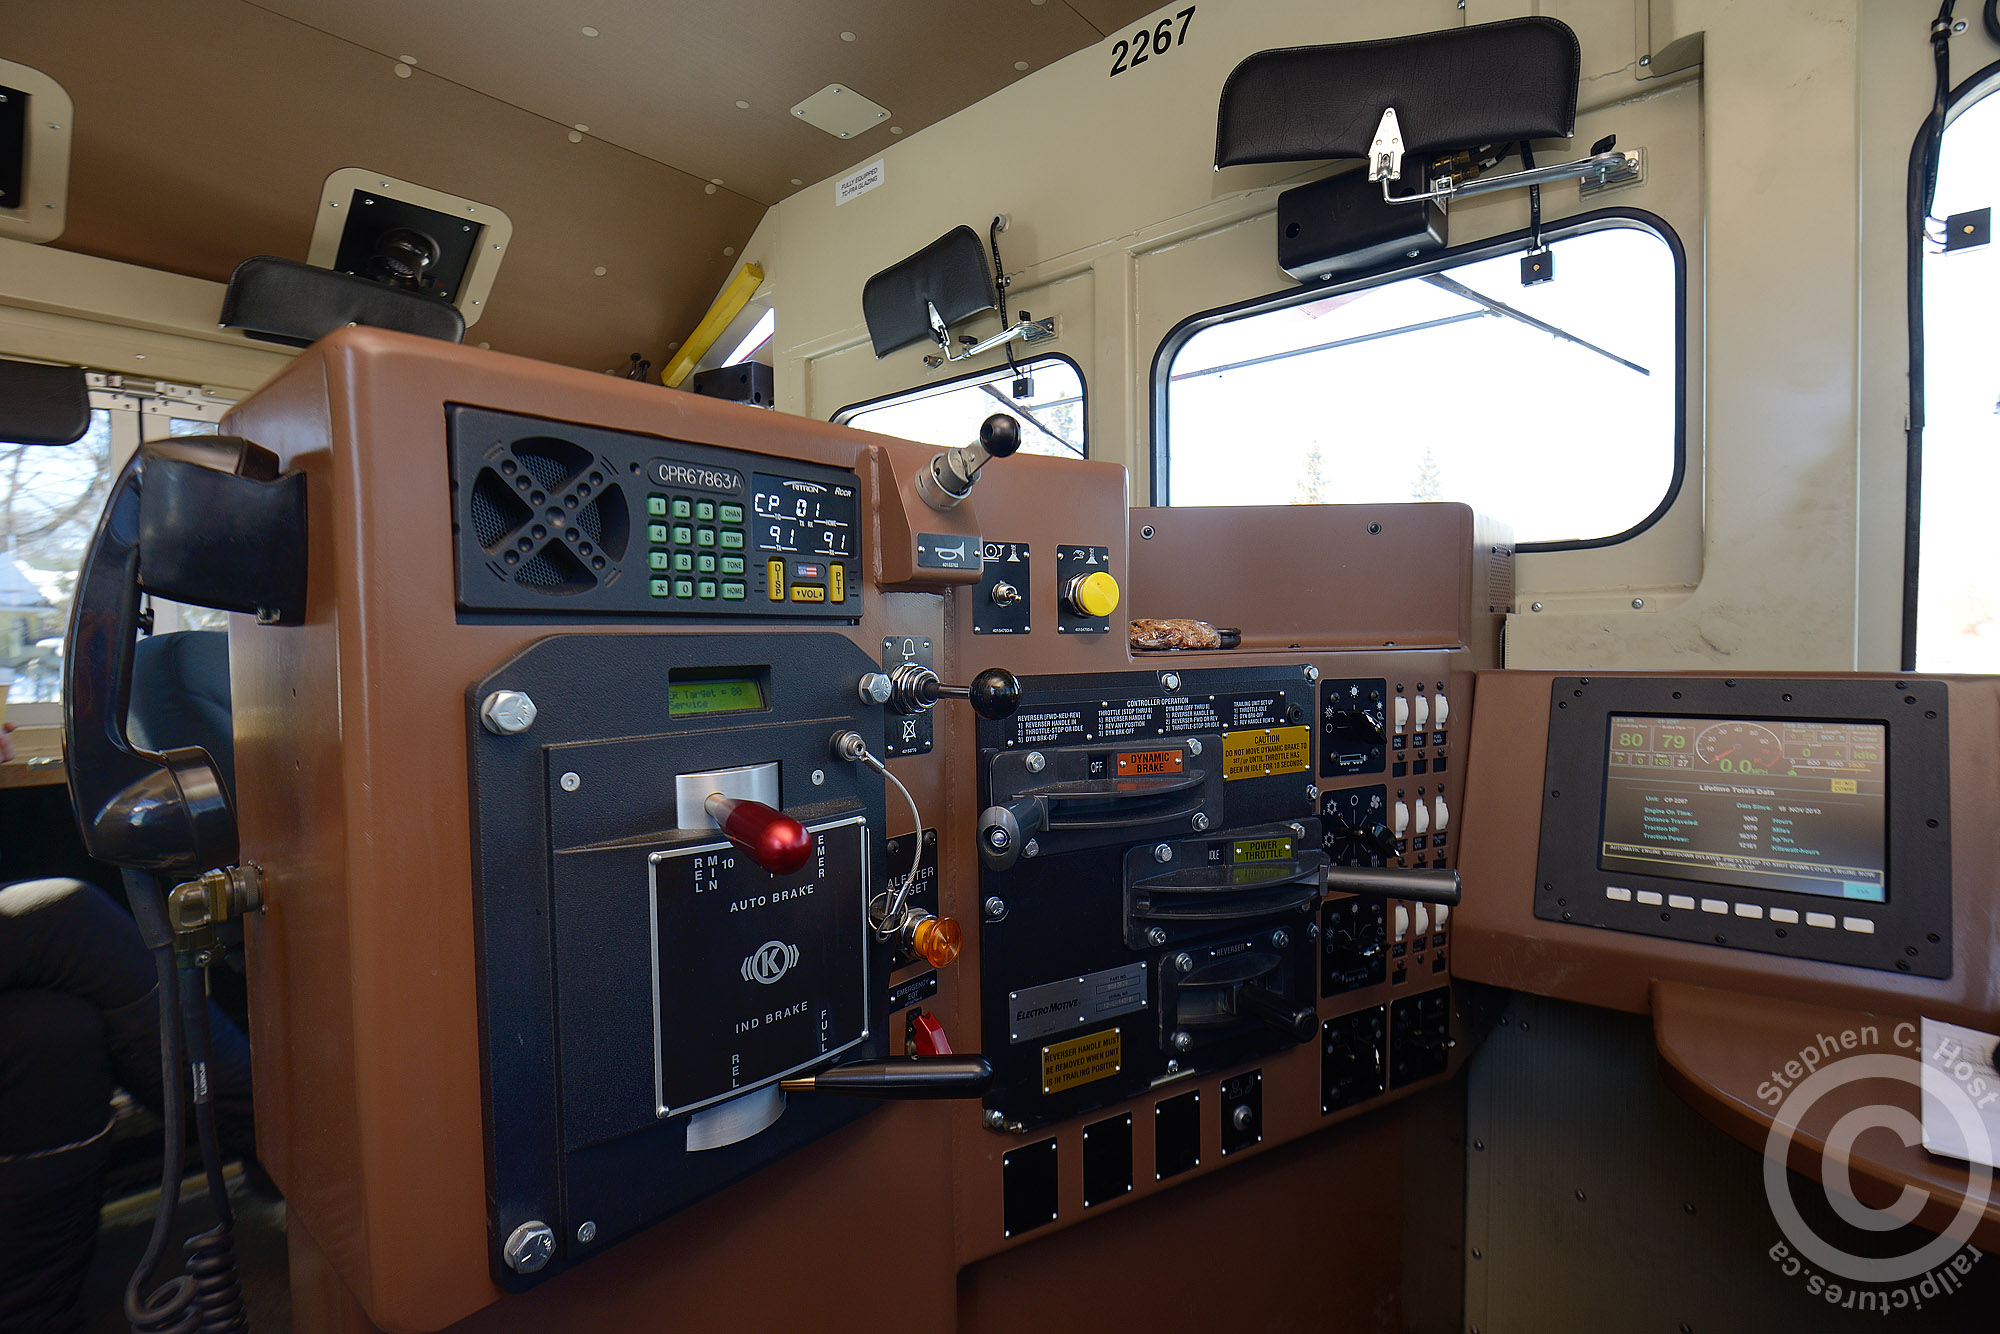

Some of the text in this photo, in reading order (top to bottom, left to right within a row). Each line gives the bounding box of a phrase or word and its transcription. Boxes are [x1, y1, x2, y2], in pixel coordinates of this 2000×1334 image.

[1110, 5, 1196, 77] 2267
[658, 464, 742, 489] CPR67863A
[656, 502, 660, 510] 1
[680, 504, 686, 513] 2
[754, 492, 780, 512] CP
[796, 499, 820, 518] 01
[704, 507, 710, 516] 3
[725, 510, 740, 518] CHAN
[656, 530, 662, 538] 4
[681, 531, 687, 540] 5
[705, 534, 710, 542] 6
[770, 526, 794, 544] 91
[824, 531, 846, 550] 91
[658, 556, 663, 564] 7
[682, 558, 688, 566] 8
[706, 560, 711, 568] 9
[682, 584, 688, 594] 0
[706, 586, 712, 594] #
[727, 587, 742, 595] HOME
[801, 590, 818, 598] VOL
[684, 688, 716, 700] Target
[670, 701, 708, 710] Service
[1126, 697, 1188, 708] CONTROLLER OPERATION
[1026, 720, 1050, 728] REVERSER
[1026, 726, 1064, 736] THROTTLE-STOP
[1255, 735, 1280, 744] CAUTION
[1619, 733, 1644, 746] 80
[1662, 734, 1686, 748] 79
[1261, 745, 1284, 754] DYNAMIC
[1284, 743, 1300, 751] BRAKE
[1802, 748, 1811, 758] 0
[1131, 752, 1169, 764] DYNAMIC
[1265, 753, 1288, 762] THROTTLE
[1853, 750, 1878, 760] Idle
[1091, 762, 1102, 773] OFF
[1137, 763, 1164, 773] BRAKE
[1280, 760, 1302, 768] SECONDS
[1720, 758, 1752, 774] 0.0
[1699, 784, 1730, 793] Lifetime
[1732, 786, 1754, 794] Totals
[1644, 808, 1664, 816] Engine
[1644, 816, 1669, 824] Distance
[1644, 824, 1668, 832] Traction
[1643, 832, 1667, 840] Traction
[1250, 841, 1277, 850] POWER
[1208, 850, 1220, 860] IDLE
[1246, 849, 1282, 860] THROTTLE
[1610, 844, 1640, 853] AUTOMATIC
[1662, 850, 1694, 858] SHUTDOWN
[817, 835, 826, 878] EMER
[722, 858, 734, 869] 10
[694, 858, 703, 892] REL
[707, 856, 718, 890] MIN
[888, 866, 934, 886] ALETER
[730, 884, 814, 912] AUTO BRAKE
[1216, 944, 1244, 956] REVERSER
[896, 979, 928, 998] EMERGENCY
[908, 990, 918, 1000] EOT
[736, 1002, 808, 1034] IND BRAKE
[1045, 1036, 1118, 1063] REVERSER HANDLE MUST
[1046, 1048, 1118, 1074] BE REMOVED WHEN UNIT
[732, 1054, 740, 1088] REL
[1047, 1060, 1118, 1086] IS IN TRAILING POSITION
